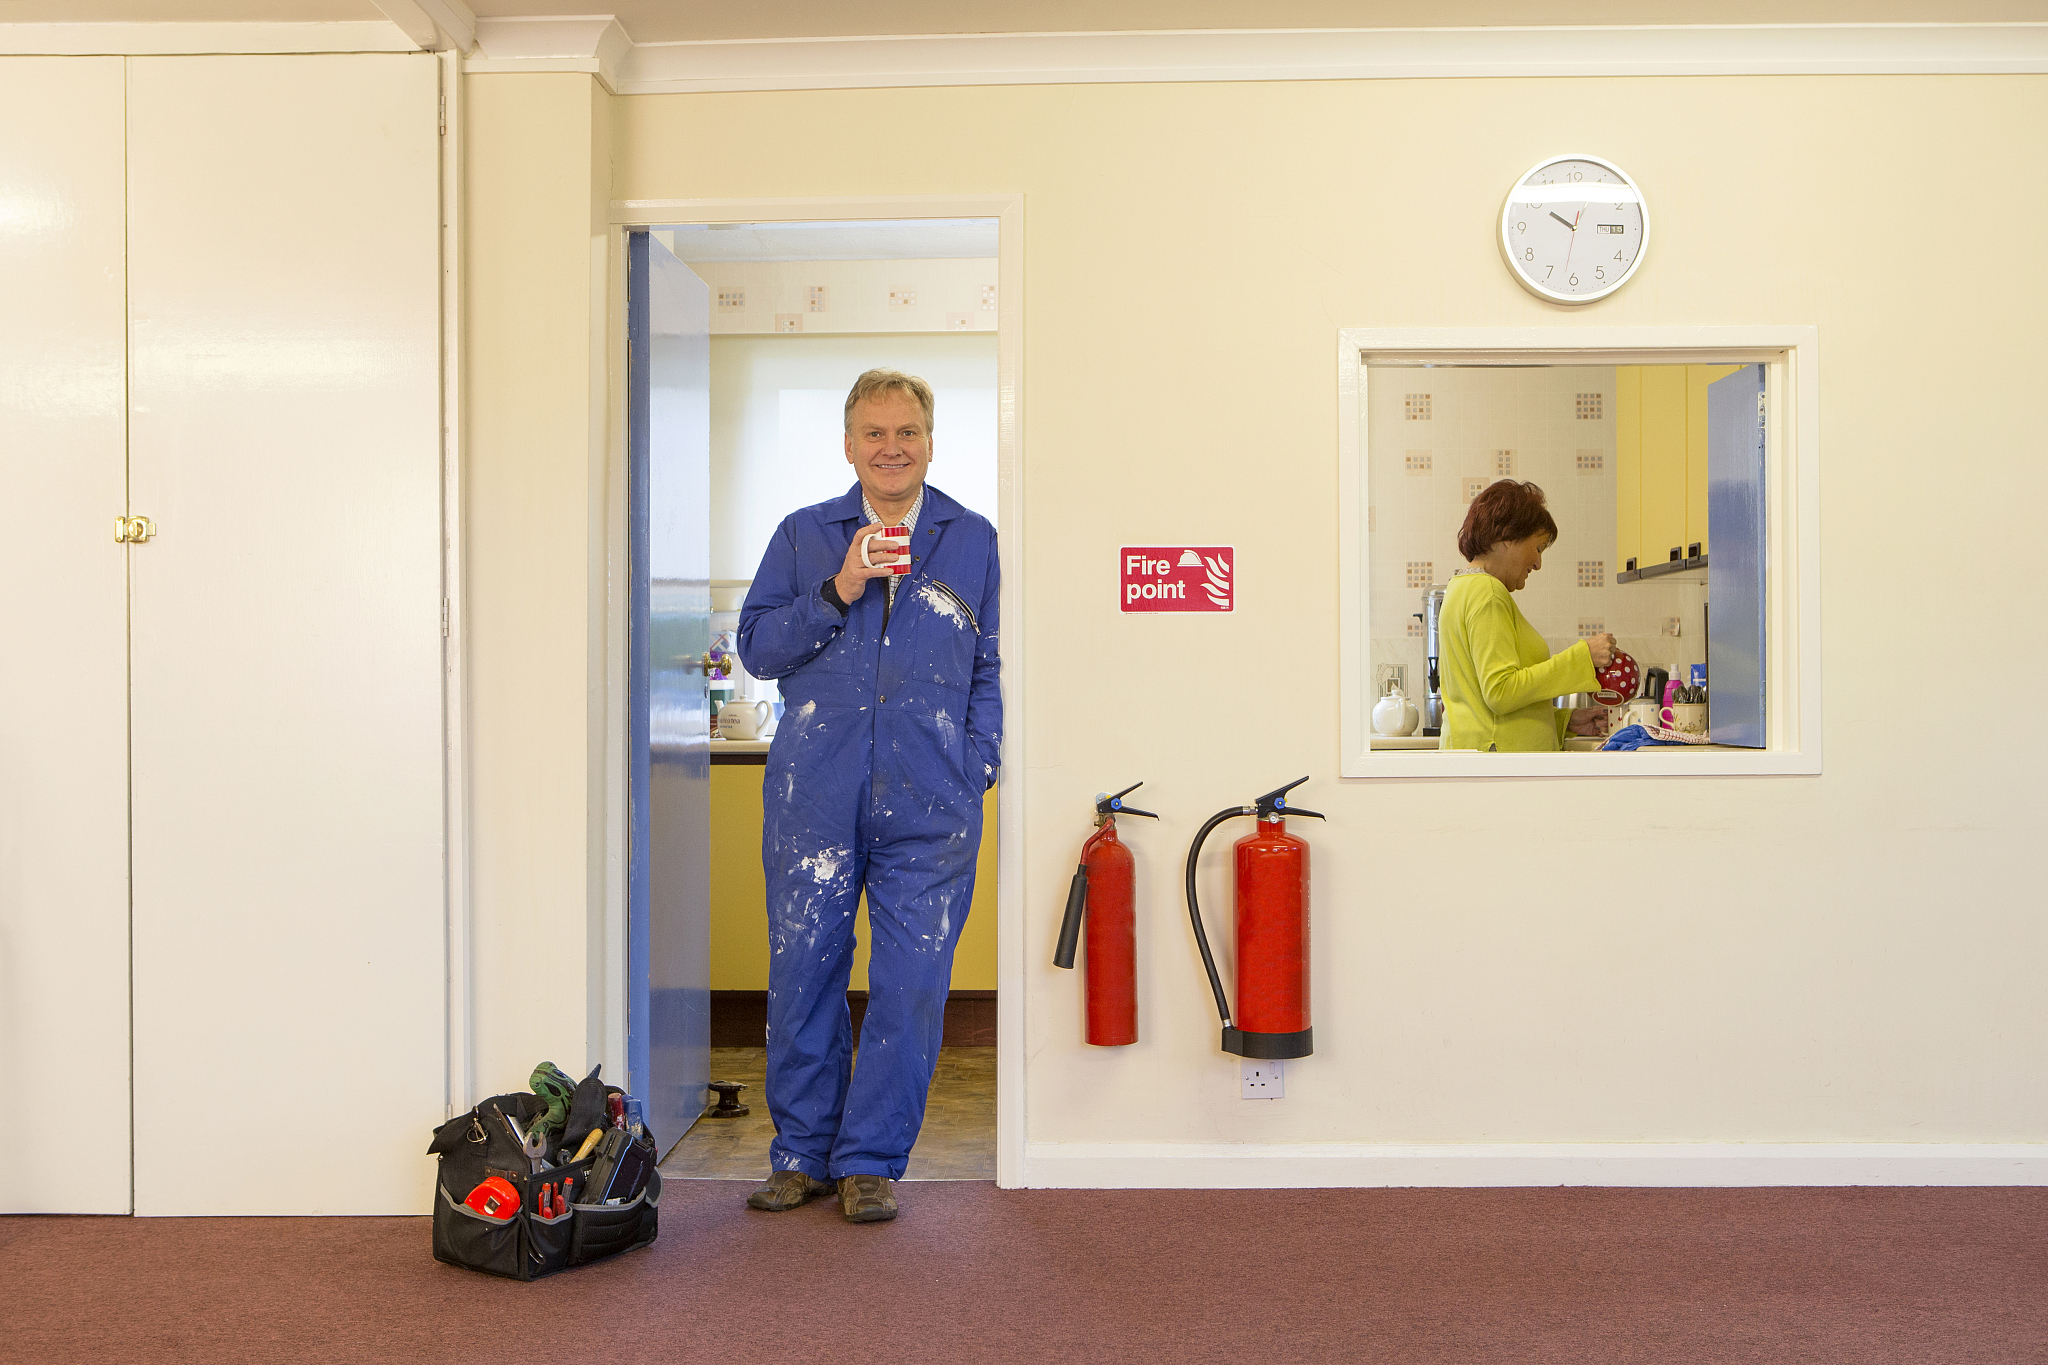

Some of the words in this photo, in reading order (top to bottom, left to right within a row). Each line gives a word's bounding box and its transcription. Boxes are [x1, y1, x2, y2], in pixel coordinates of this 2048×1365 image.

[1517, 222, 1527, 235] 9
[1525, 248, 1534, 261] 8
[1614, 250, 1623, 262] 4
[1546, 266, 1554, 279] 7
[1595, 266, 1604, 279] 5
[1569, 273, 1578, 286] 6
[1127, 555, 1170, 575] Fire
[1127, 579, 1185, 604] point
